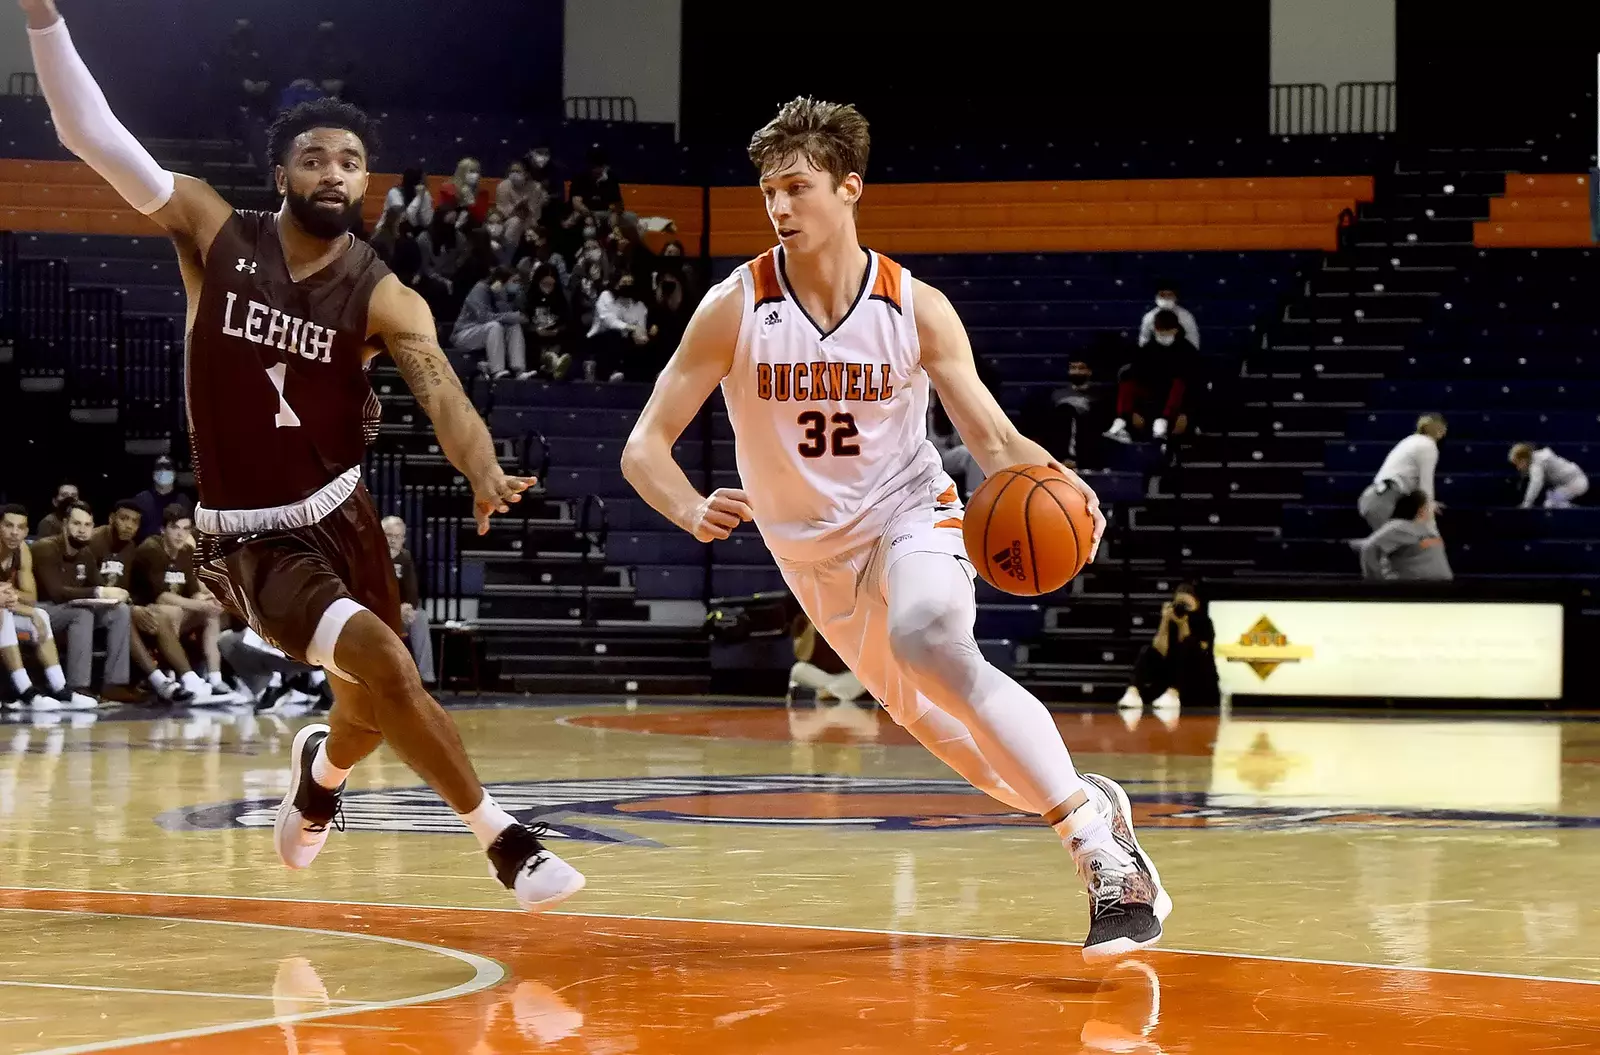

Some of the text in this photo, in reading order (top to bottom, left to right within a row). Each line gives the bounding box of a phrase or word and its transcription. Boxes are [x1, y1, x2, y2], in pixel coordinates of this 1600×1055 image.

[222, 291, 337, 363] LEHIGH
[265, 362, 301, 428] 1
[757, 361, 893, 402] BUCKNELL
[797, 411, 861, 458] 32
[1011, 540, 1026, 581] adidas
